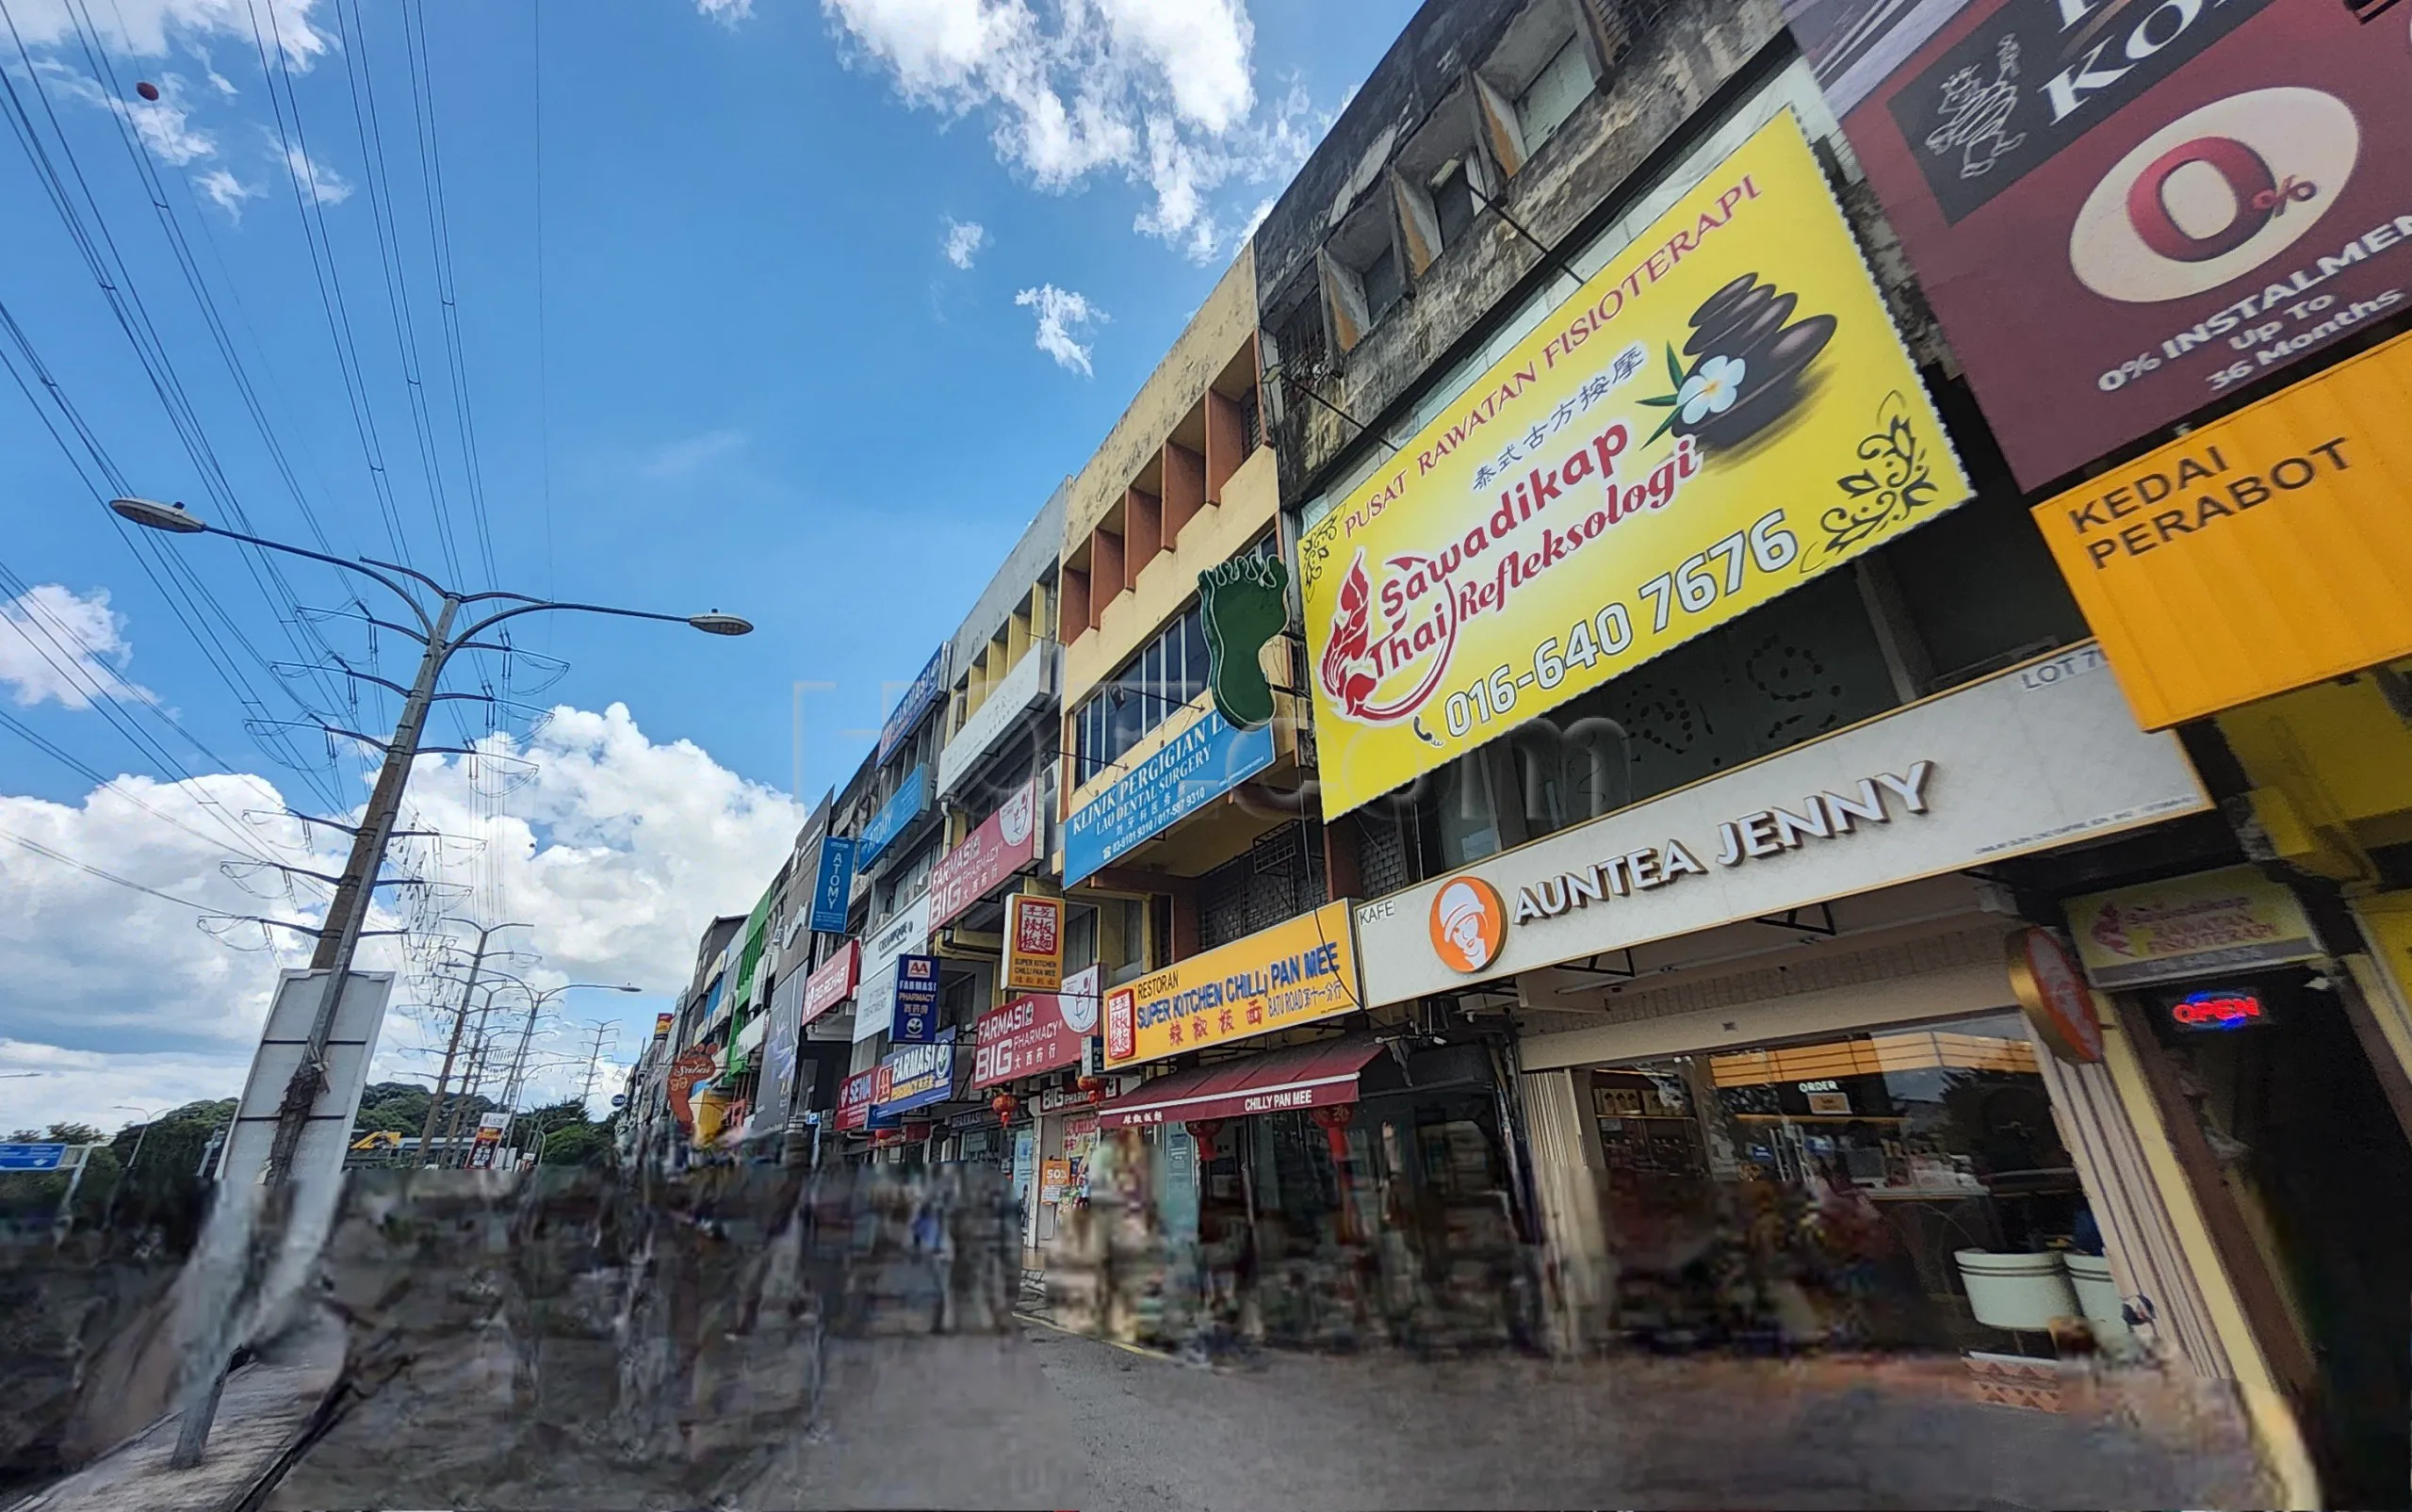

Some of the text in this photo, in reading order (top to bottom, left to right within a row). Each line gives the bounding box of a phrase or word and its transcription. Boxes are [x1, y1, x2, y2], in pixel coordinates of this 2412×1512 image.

[2036, 0, 2229, 126] KO
[1345, 174, 1763, 538] PUSAT RAWATAN FISIOTERAPI
[2206, 288, 2405, 391] 36 Months
[2098, 352, 2161, 391] 0%
[1474, 346, 1643, 491] 泰式古方按摩
[2068, 445, 2230, 534] KEDAI
[2086, 436, 2352, 570] PERABOT
[1381, 424, 1627, 618] Sawadikap
[1366, 438, 1698, 682] Thai Refleksologi
[1445, 508, 1799, 738] 016-640 7676
[2021, 657, 2076, 690] LOT
[1073, 789, 1117, 835] KLINIK
[1119, 722, 1207, 801] PERGIGIAN
[1096, 811, 1115, 836] LAU
[1116, 786, 1158, 821] DENTAL
[1159, 742, 1212, 793] SURGERY
[932, 840, 973, 893] FARMASI
[1511, 838, 1707, 927] AUNTEA
[1716, 760, 1934, 867] JENNY
[827, 852, 842, 910] ATOMY
[929, 876, 962, 928] BIG
[1358, 900, 1395, 926] KAFE
[899, 980, 937, 991] FARMASI
[1136, 998, 1171, 1031] SUPER
[1271, 953, 1301, 990] PAN
[1304, 941, 1341, 981] MEE
[1137, 969, 1179, 1000] RESTORAN
[1268, 994, 1284, 1017] BATU
[1284, 988, 1303, 1013] ROAD
[2172, 997, 2260, 1024] OPEN
[974, 1020, 1059, 1082] BIG PHARMACY
[977, 1002, 1026, 1045] FARMASI
[892, 1044, 936, 1084] FARMASI
[1799, 1080, 1838, 1093] ORDER
[1042, 1086, 1064, 1110] BIG
[1244, 1089, 1312, 1112] CHILLY PAN MEE
